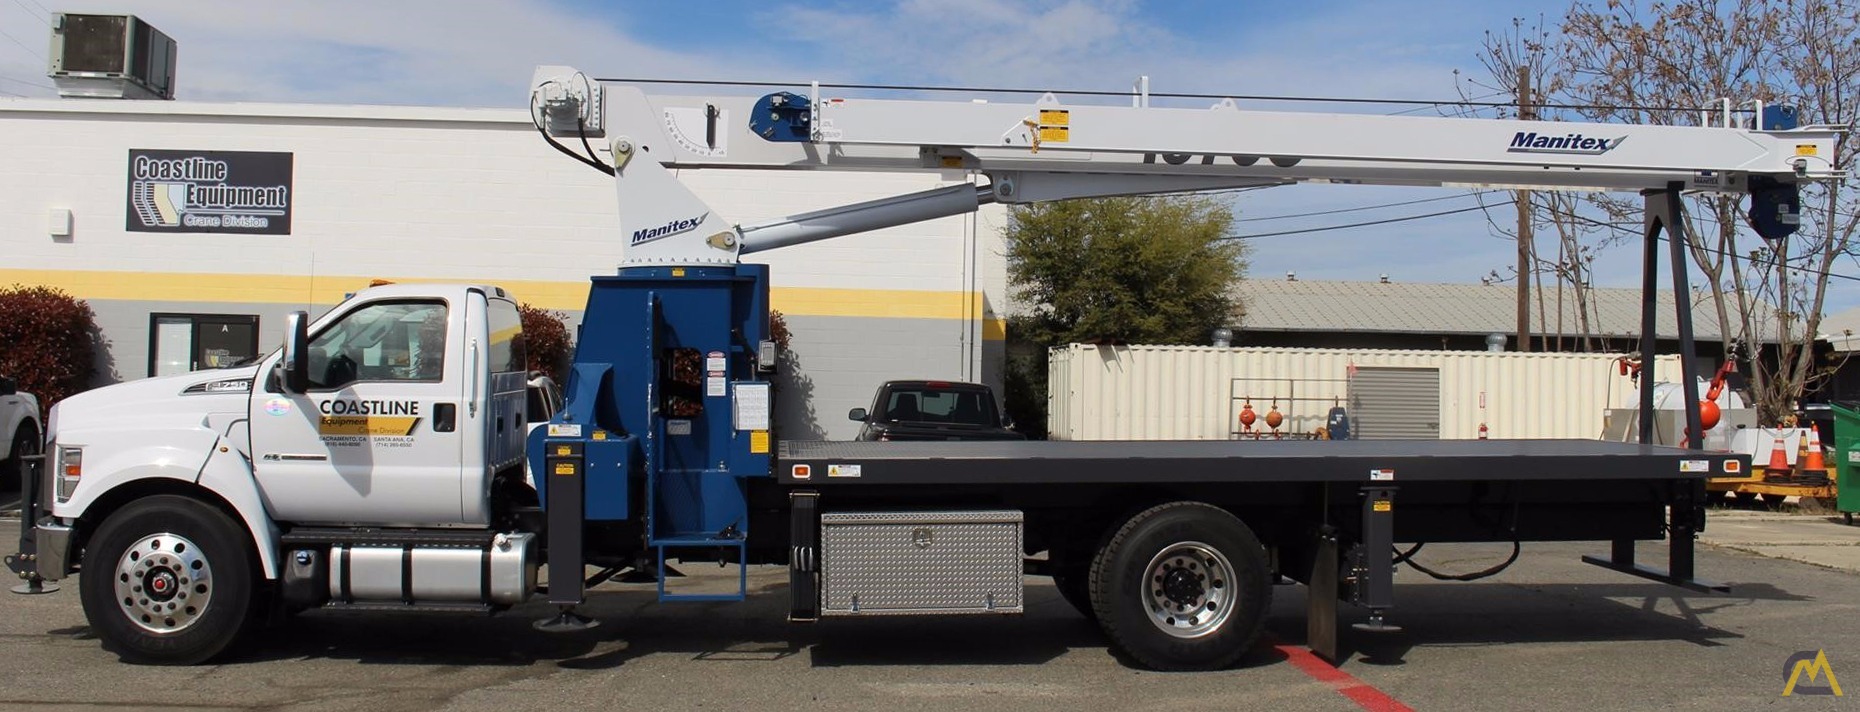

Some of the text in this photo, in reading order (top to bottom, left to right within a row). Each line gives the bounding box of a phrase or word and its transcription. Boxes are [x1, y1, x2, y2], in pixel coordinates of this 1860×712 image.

[1509, 132, 1611, 150] Manitex
[135, 155, 227, 180] Coastline
[185, 183, 287, 207] Equipment
[184, 215, 268, 228] Crane Division
[631, 216, 699, 243] Manitex
[222, 324, 229, 333] A
[320, 400, 419, 415] COASTLINE
[321, 417, 368, 427] Equipment
